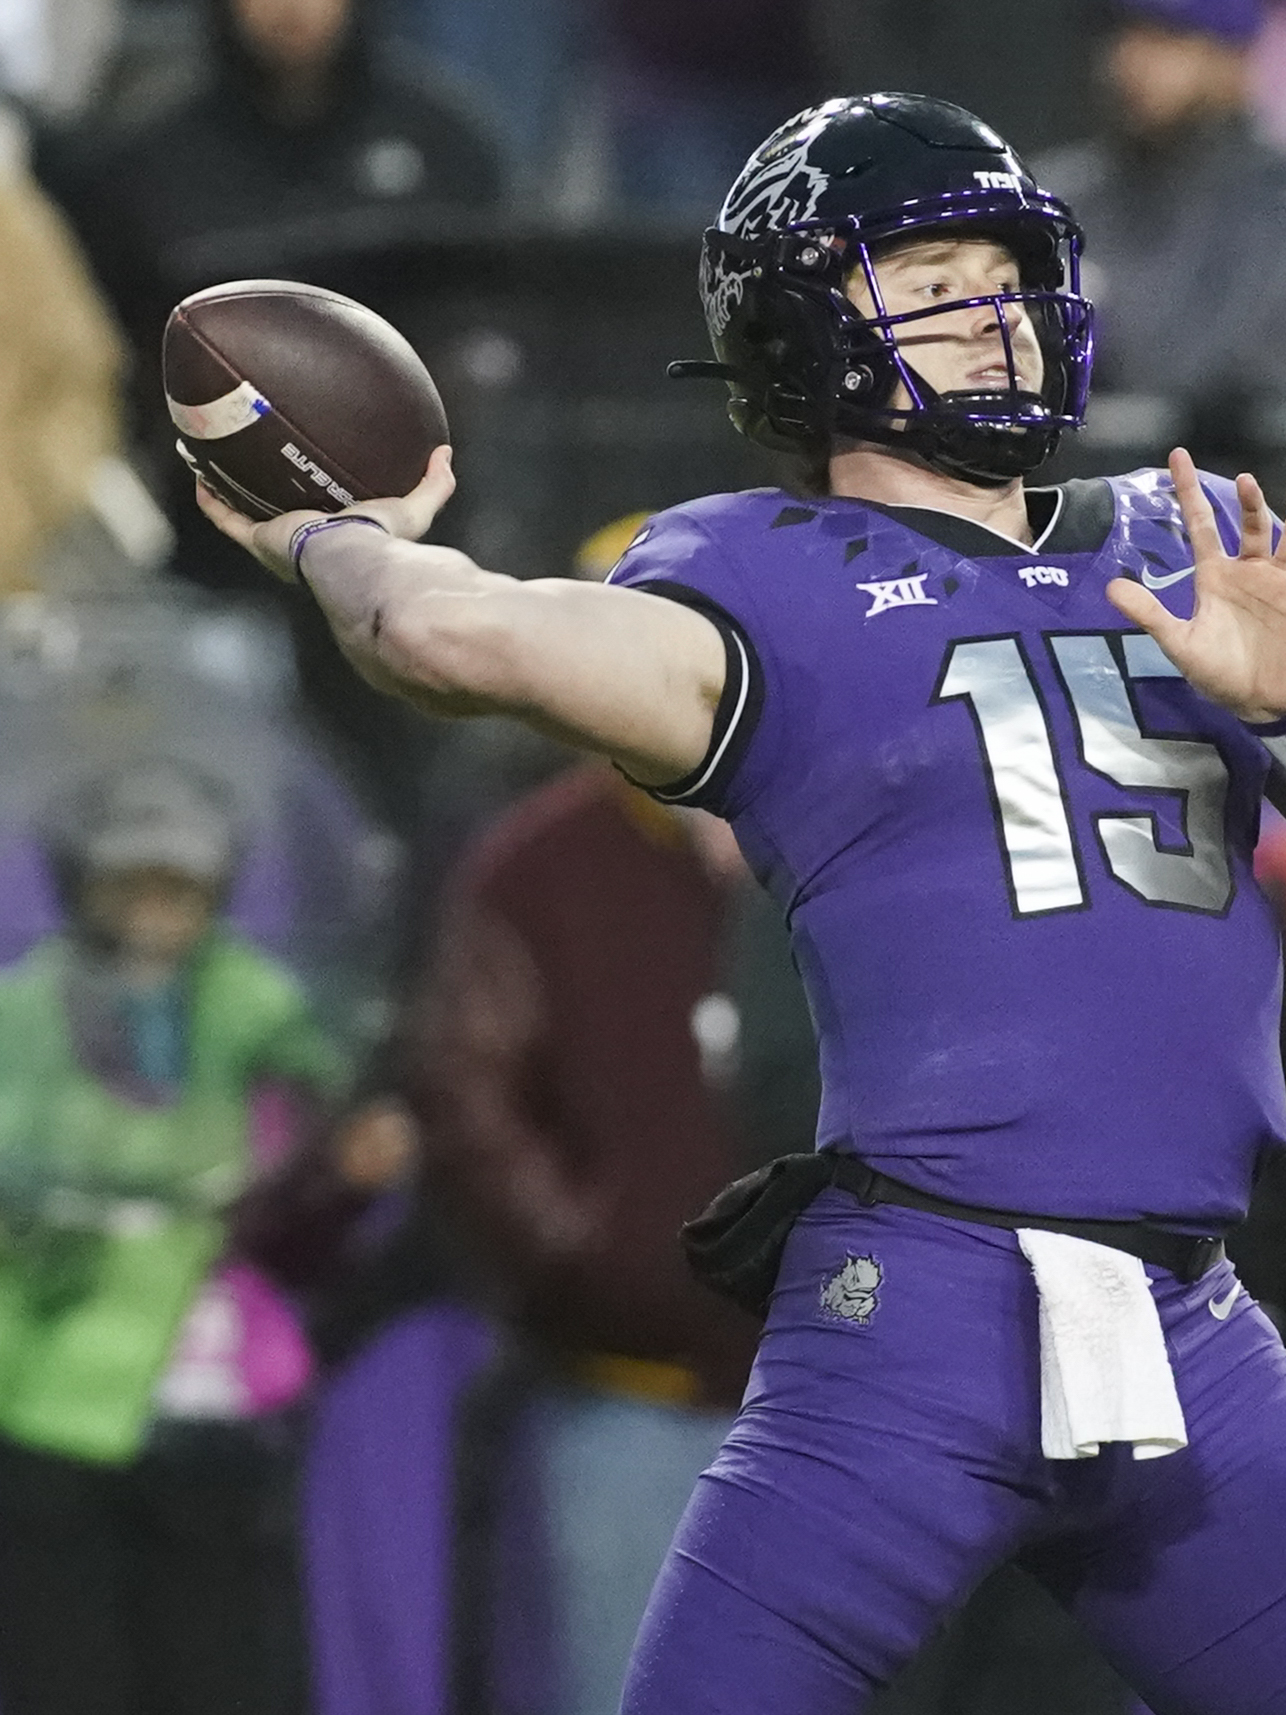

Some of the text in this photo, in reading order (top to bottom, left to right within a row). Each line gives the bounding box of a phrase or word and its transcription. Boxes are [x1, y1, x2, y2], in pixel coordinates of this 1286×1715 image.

[280, 441, 333, 487] ELITE
[856, 572, 938, 618] XII
[1017, 566, 1069, 588] TCU
[929, 630, 1236, 918] 15
